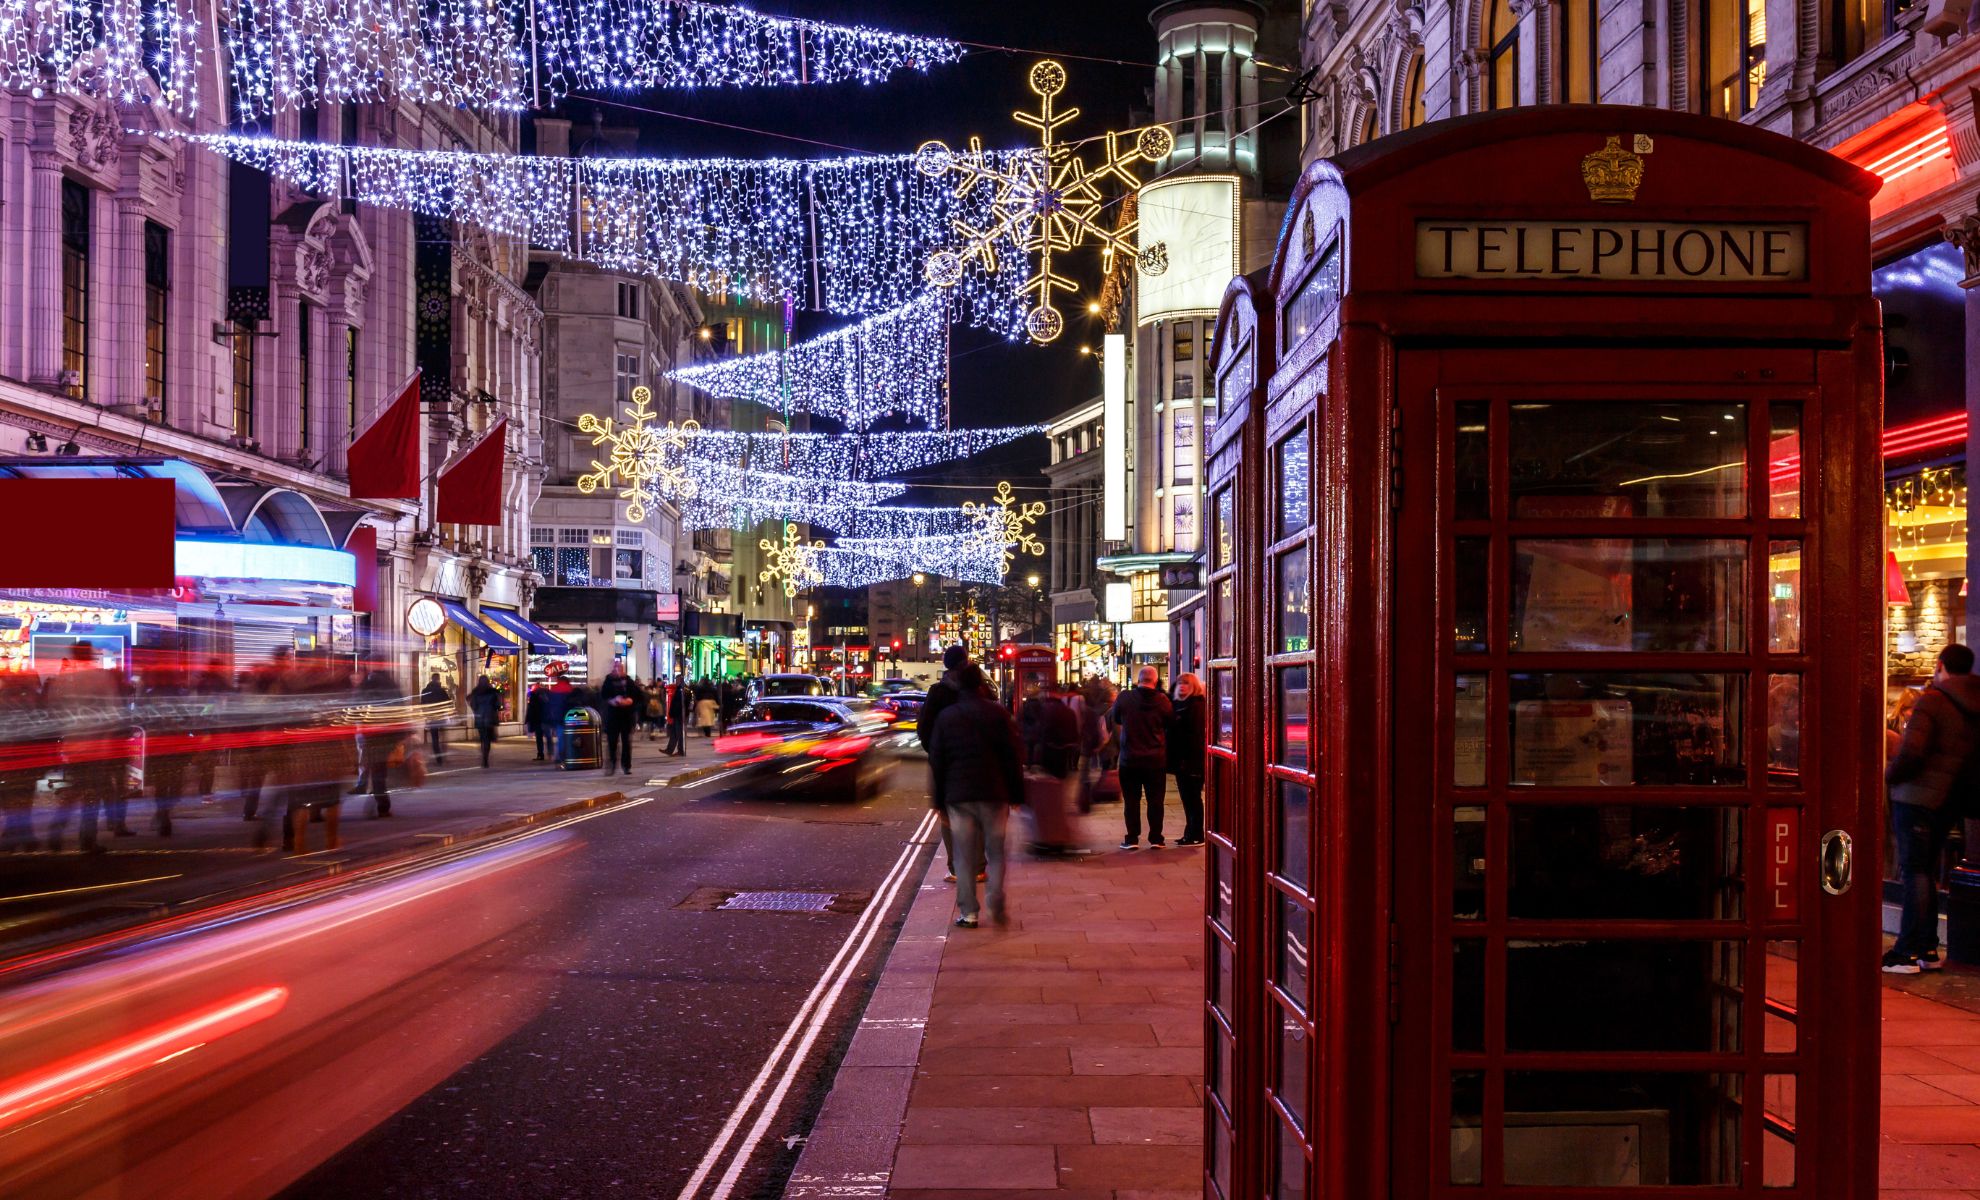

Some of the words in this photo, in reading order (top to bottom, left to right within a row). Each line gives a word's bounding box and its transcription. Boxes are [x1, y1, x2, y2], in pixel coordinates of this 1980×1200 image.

[1428, 227, 1791, 277] TELEPHONE
[33, 588, 44, 597] &
[46, 588, 110, 599] Souvenir
[545, 663, 568, 676] SALE
[1775, 823, 1789, 908] PULL
